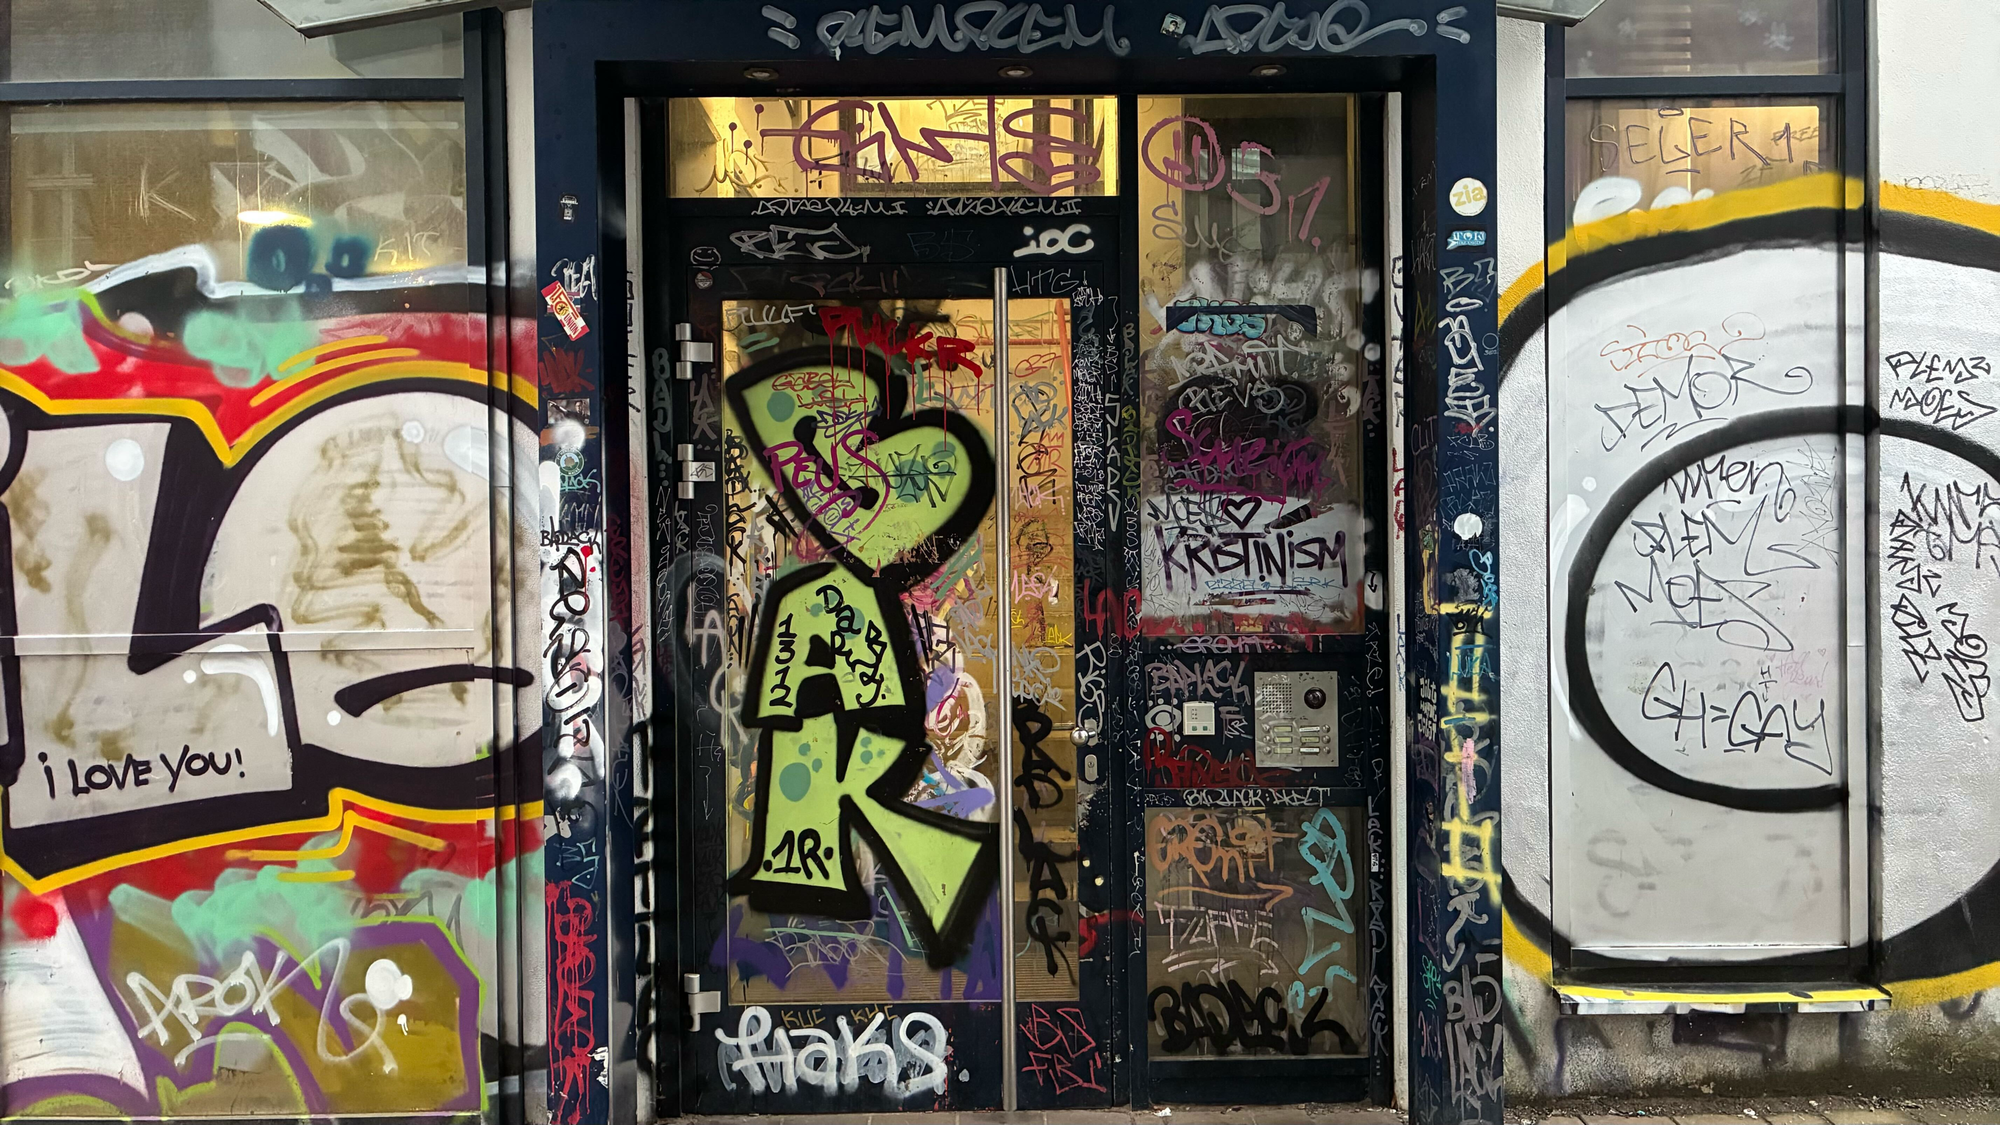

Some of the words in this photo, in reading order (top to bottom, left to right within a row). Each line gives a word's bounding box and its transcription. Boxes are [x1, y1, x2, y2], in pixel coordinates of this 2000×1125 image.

[1452, 184, 1487, 207] zia
[70, 752, 152, 797] LOVE
[159, 744, 245, 793] YOU!
